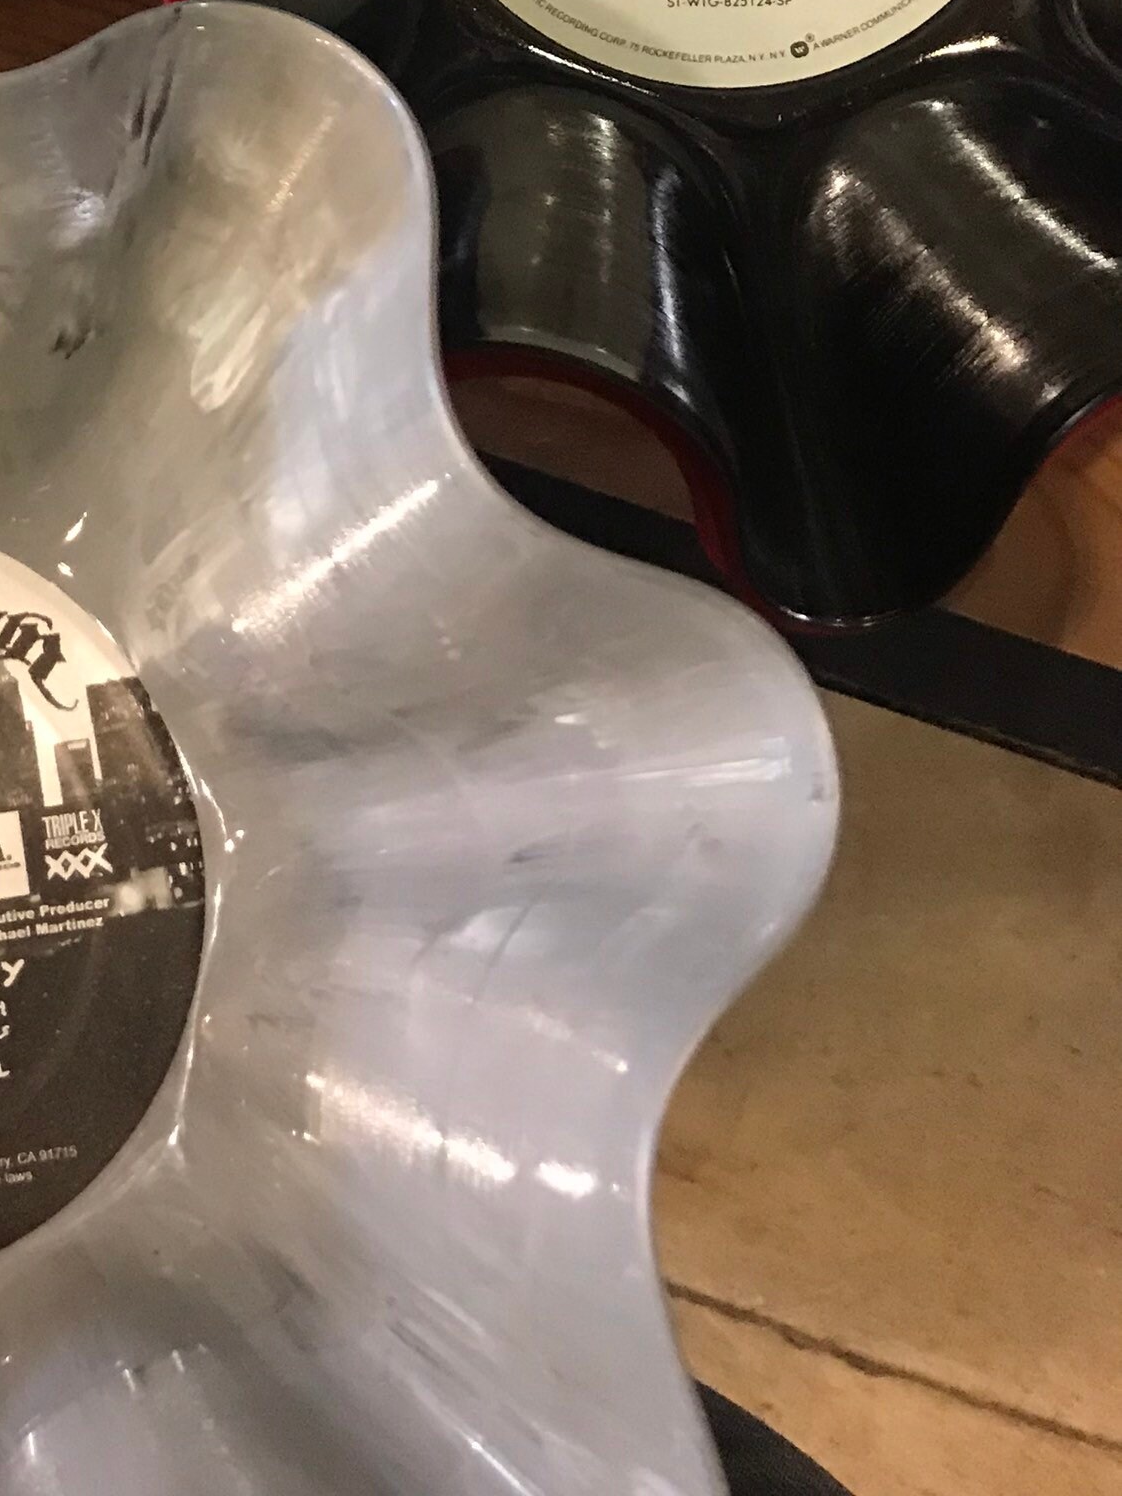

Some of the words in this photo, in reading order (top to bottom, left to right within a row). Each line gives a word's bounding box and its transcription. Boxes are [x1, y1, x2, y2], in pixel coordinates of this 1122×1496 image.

[41, 810, 90, 840] TRIPLE
[91, 808, 105, 833] X
[44, 829, 107, 851] RECORDS
[44, 842, 114, 881] XXX
[39, 897, 110, 918] Producer
[35, 916, 104, 936] Martinez
[17, 1151, 37, 1165] CA
